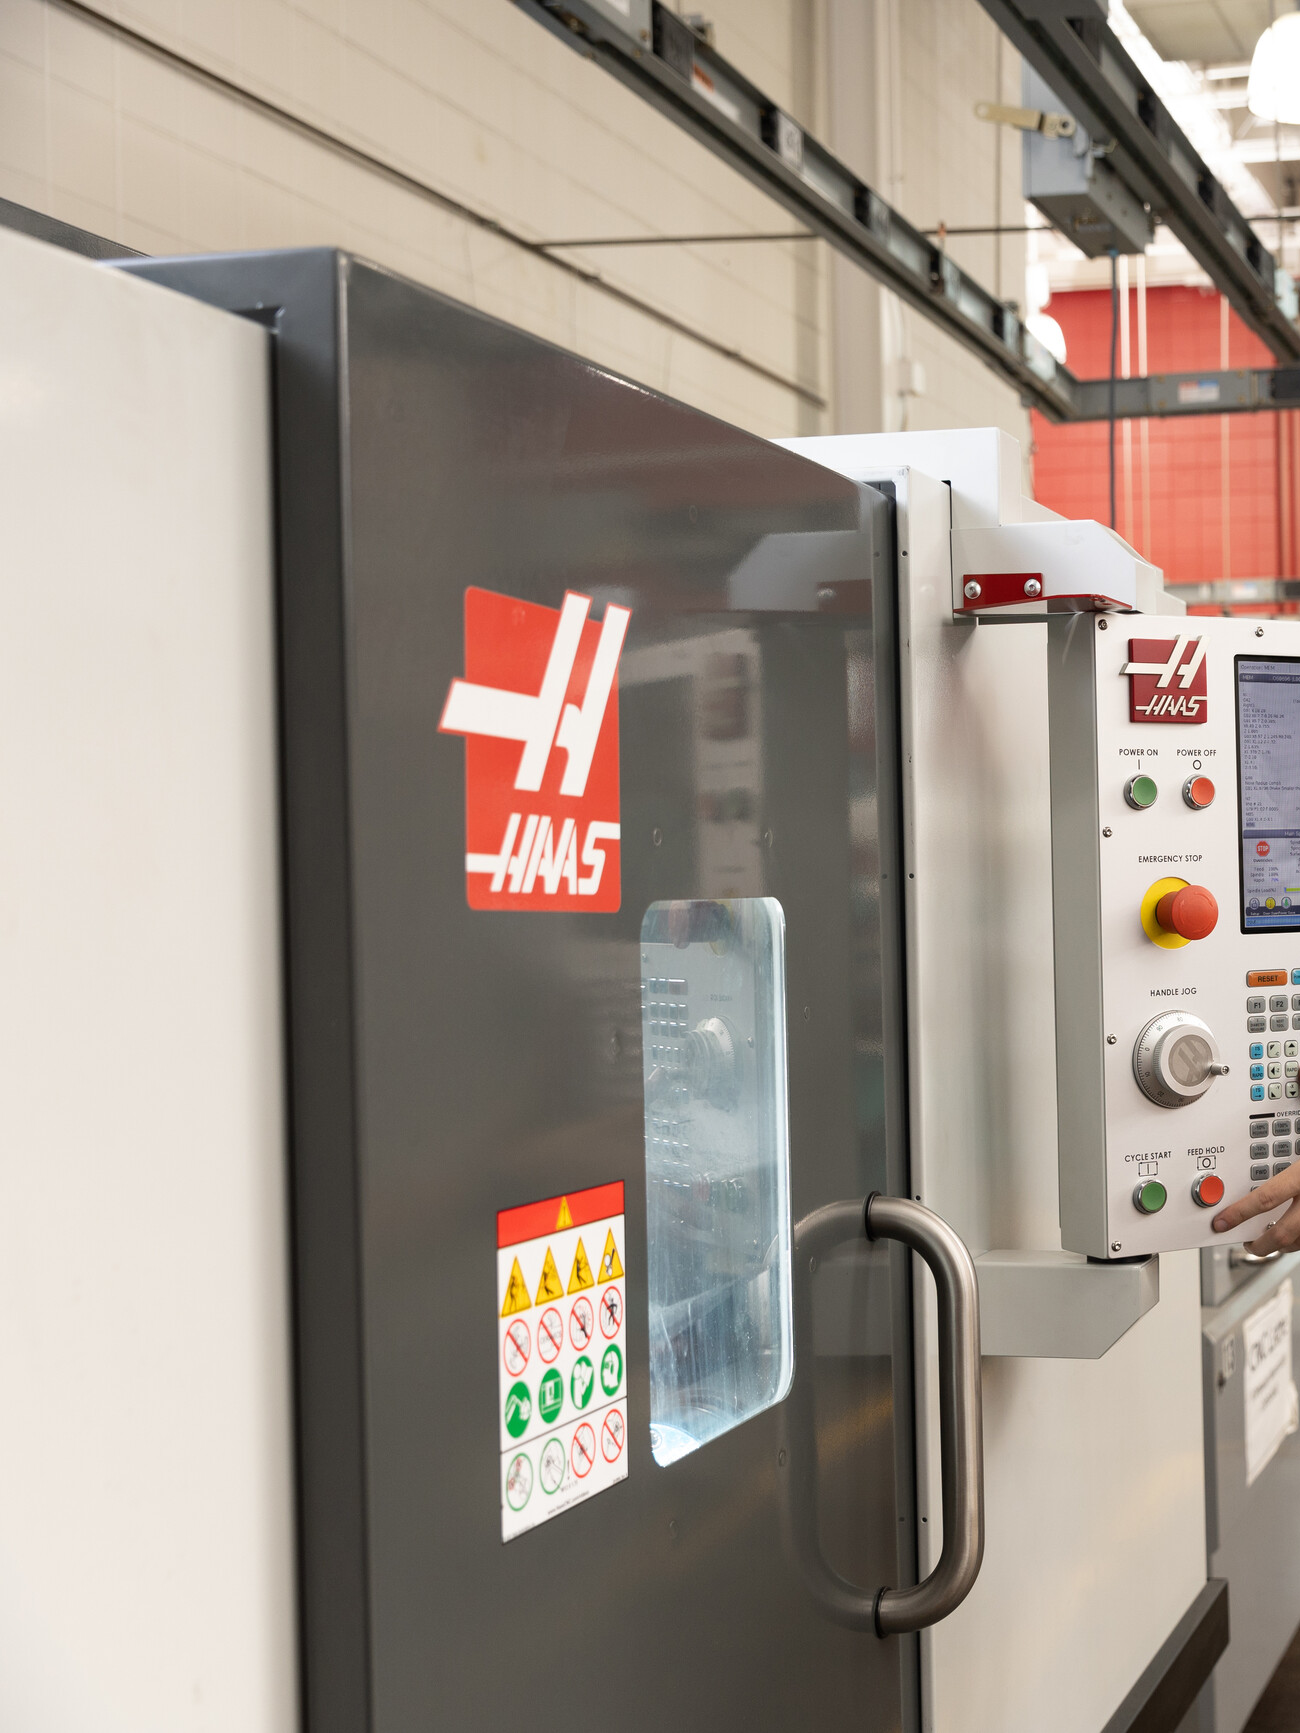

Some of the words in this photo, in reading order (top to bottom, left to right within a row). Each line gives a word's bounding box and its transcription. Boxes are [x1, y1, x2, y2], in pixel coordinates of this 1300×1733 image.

[1135, 695, 1207, 716] HAAS
[465, 812, 620, 895] HAAS
[1138, 855, 1182, 863] EMERGENCY
[1185, 854, 1203, 862] STOP
[1150, 988, 1179, 997] HANDLE
[1181, 987, 1197, 996] JOG
[1188, 1148, 1203, 1156] FEED
[1206, 1146, 1225, 1154] HOLD
[1125, 1153, 1148, 1162] CYCLE
[1151, 1151, 1171, 1160] START
